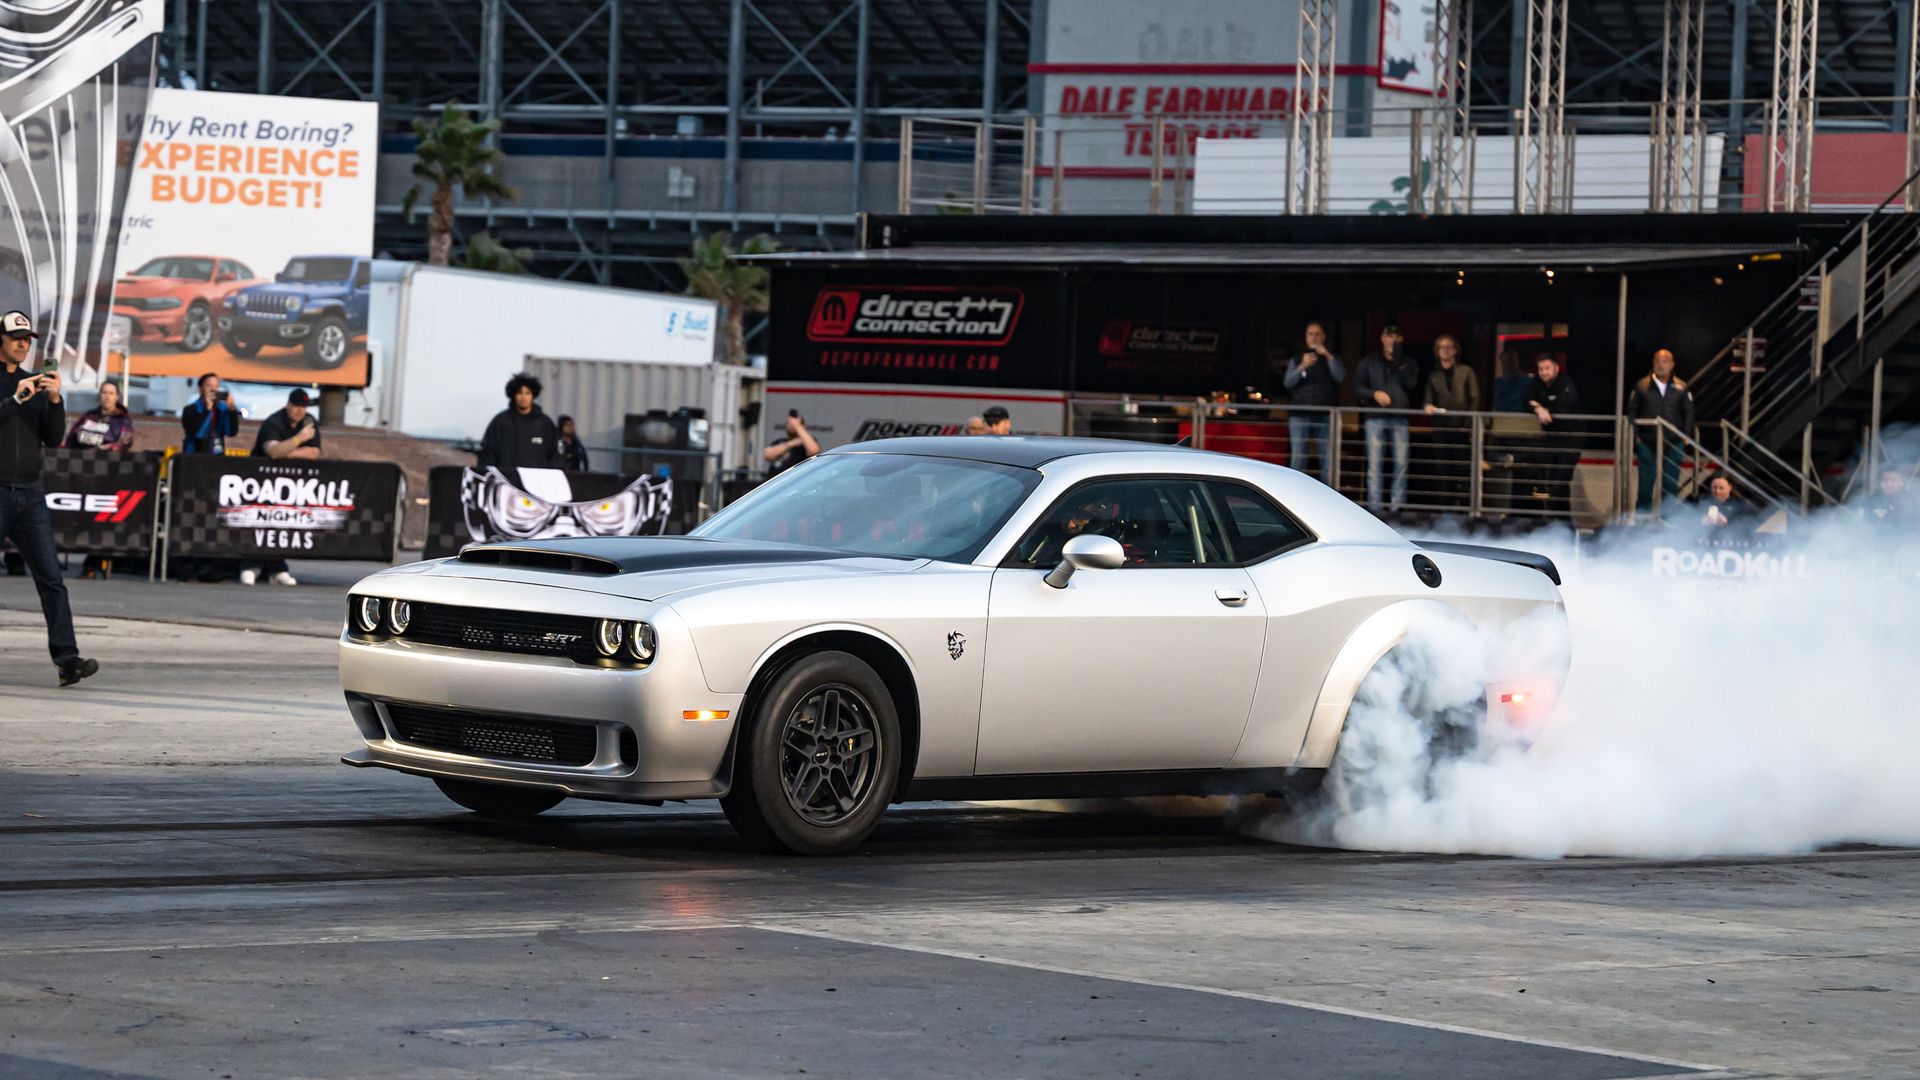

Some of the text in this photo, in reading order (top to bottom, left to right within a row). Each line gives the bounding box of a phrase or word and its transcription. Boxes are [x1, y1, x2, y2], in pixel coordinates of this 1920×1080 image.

[1059, 86, 1137, 119] DALE
[188, 116, 249, 139] Rent
[255, 119, 354, 148] Boring?
[151, 174, 323, 208] BUDGET!
[859, 294, 989, 319] direct
[854, 317, 1009, 335] connection
[219, 474, 353, 507] ROADKILL
[254, 529, 314, 550] VEGAS
[1651, 547, 1808, 578] ROADKILL
[542, 632, 582, 644] SRT
